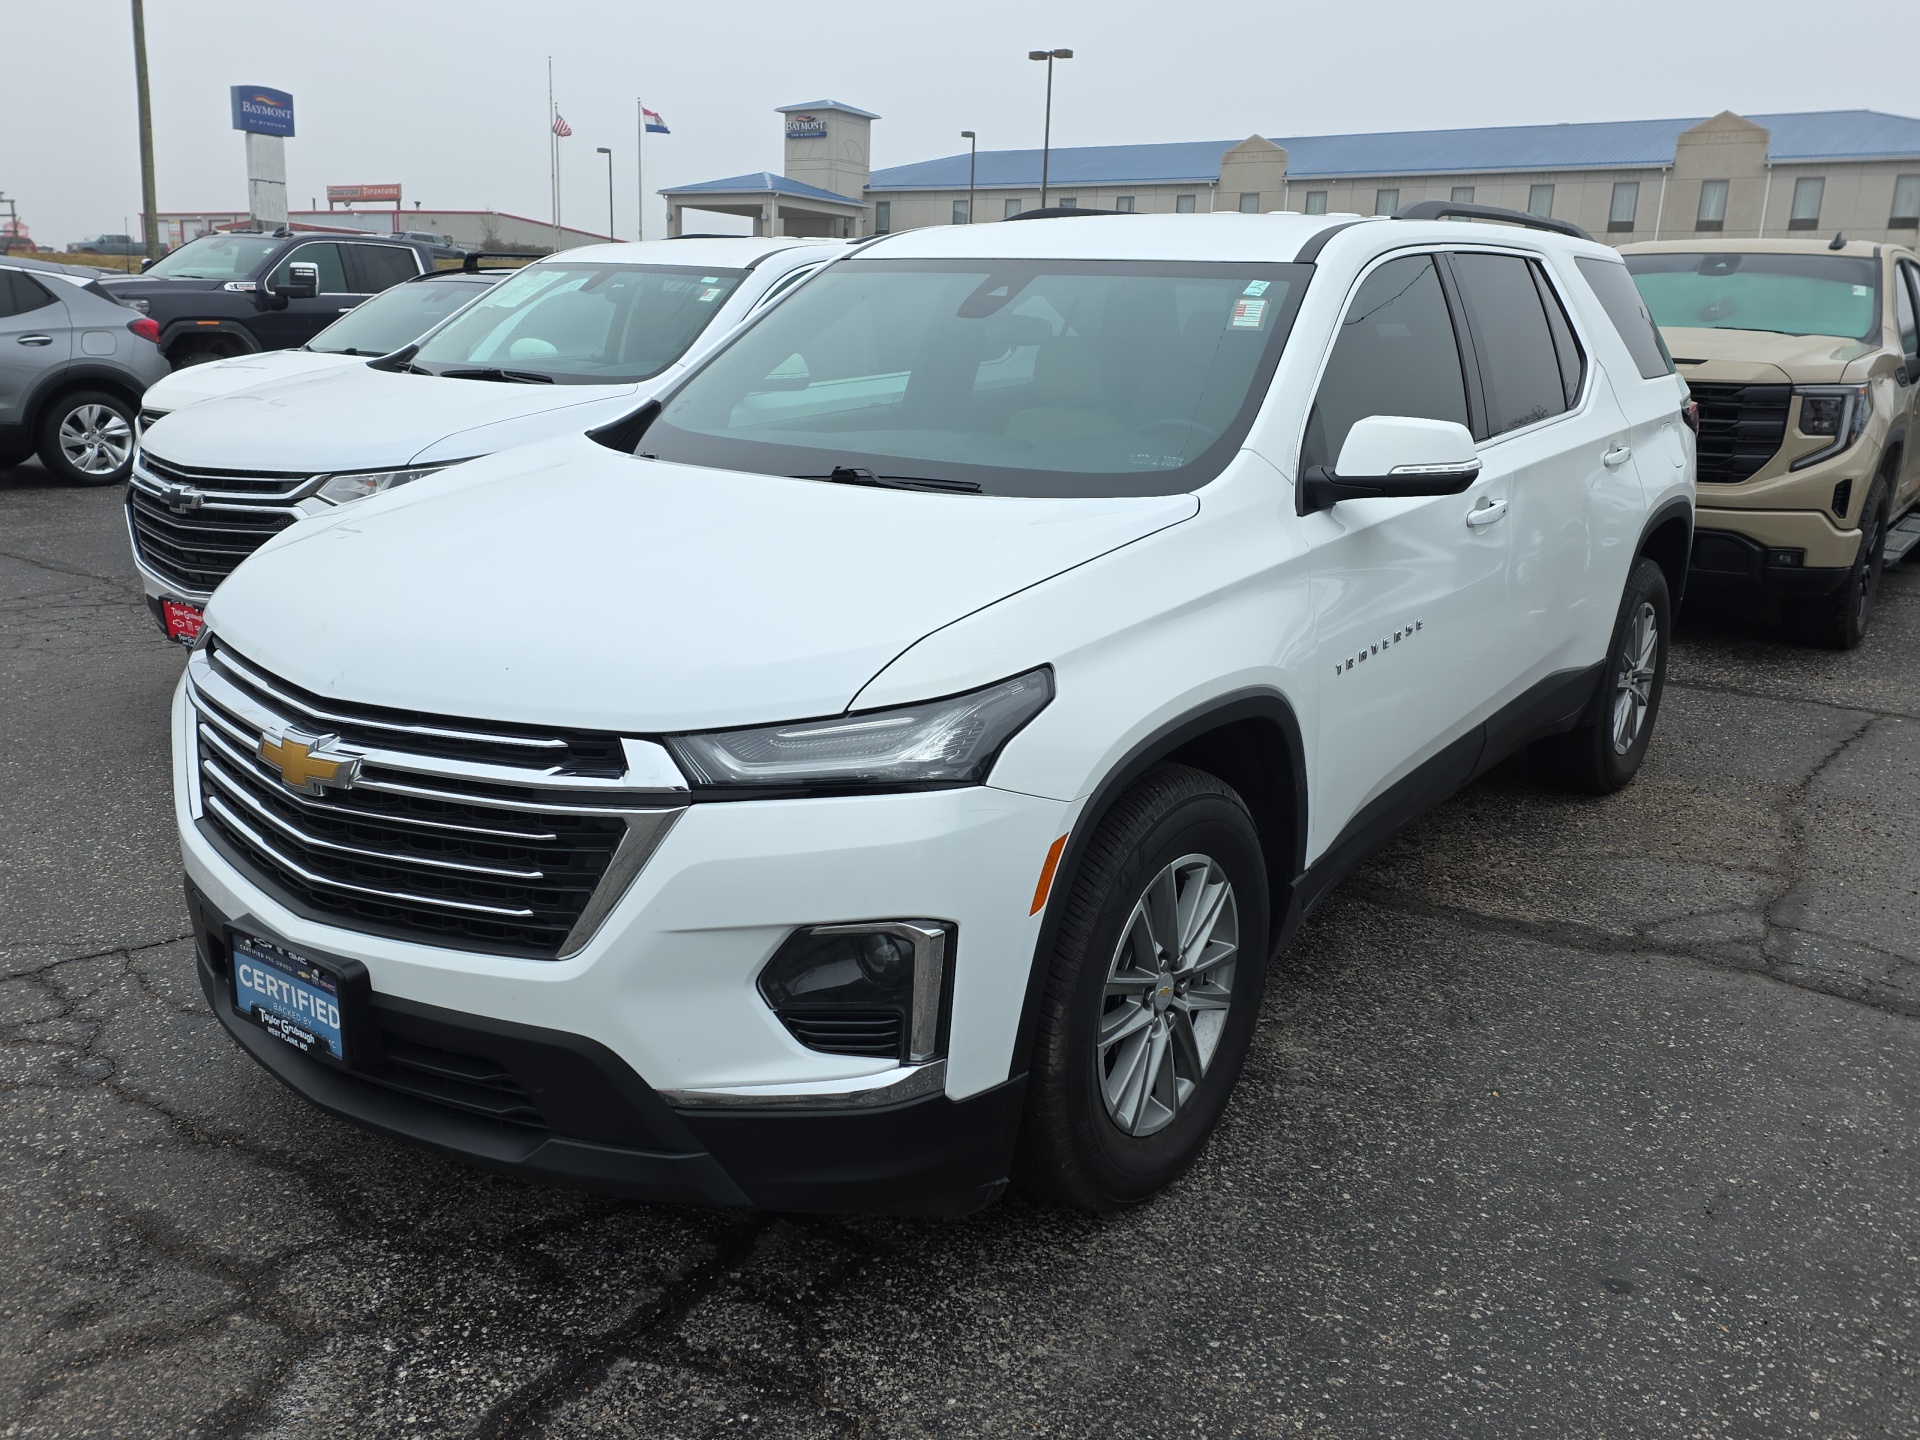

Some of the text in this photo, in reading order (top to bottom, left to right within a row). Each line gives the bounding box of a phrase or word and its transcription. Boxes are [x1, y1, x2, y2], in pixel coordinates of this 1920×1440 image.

[242, 101, 291, 119] BAYMONT
[786, 121, 824, 131] BAYMONT
[362, 186, 398, 197] Firestone
[1335, 618, 1423, 675] TRAVERSE
[240, 944, 264, 959] CERTIFIED
[288, 952, 307, 965] GMC
[319, 980, 336, 992] GMC
[239, 964, 340, 1030] CERTIFIED
[273, 1002, 312, 1026] BACKED BY
[259, 1008, 280, 1027] Taylor
[280, 1019, 315, 1044] Grubaugh
[268, 1026, 281, 1037] WEST
[299, 1041, 308, 1051] MO
